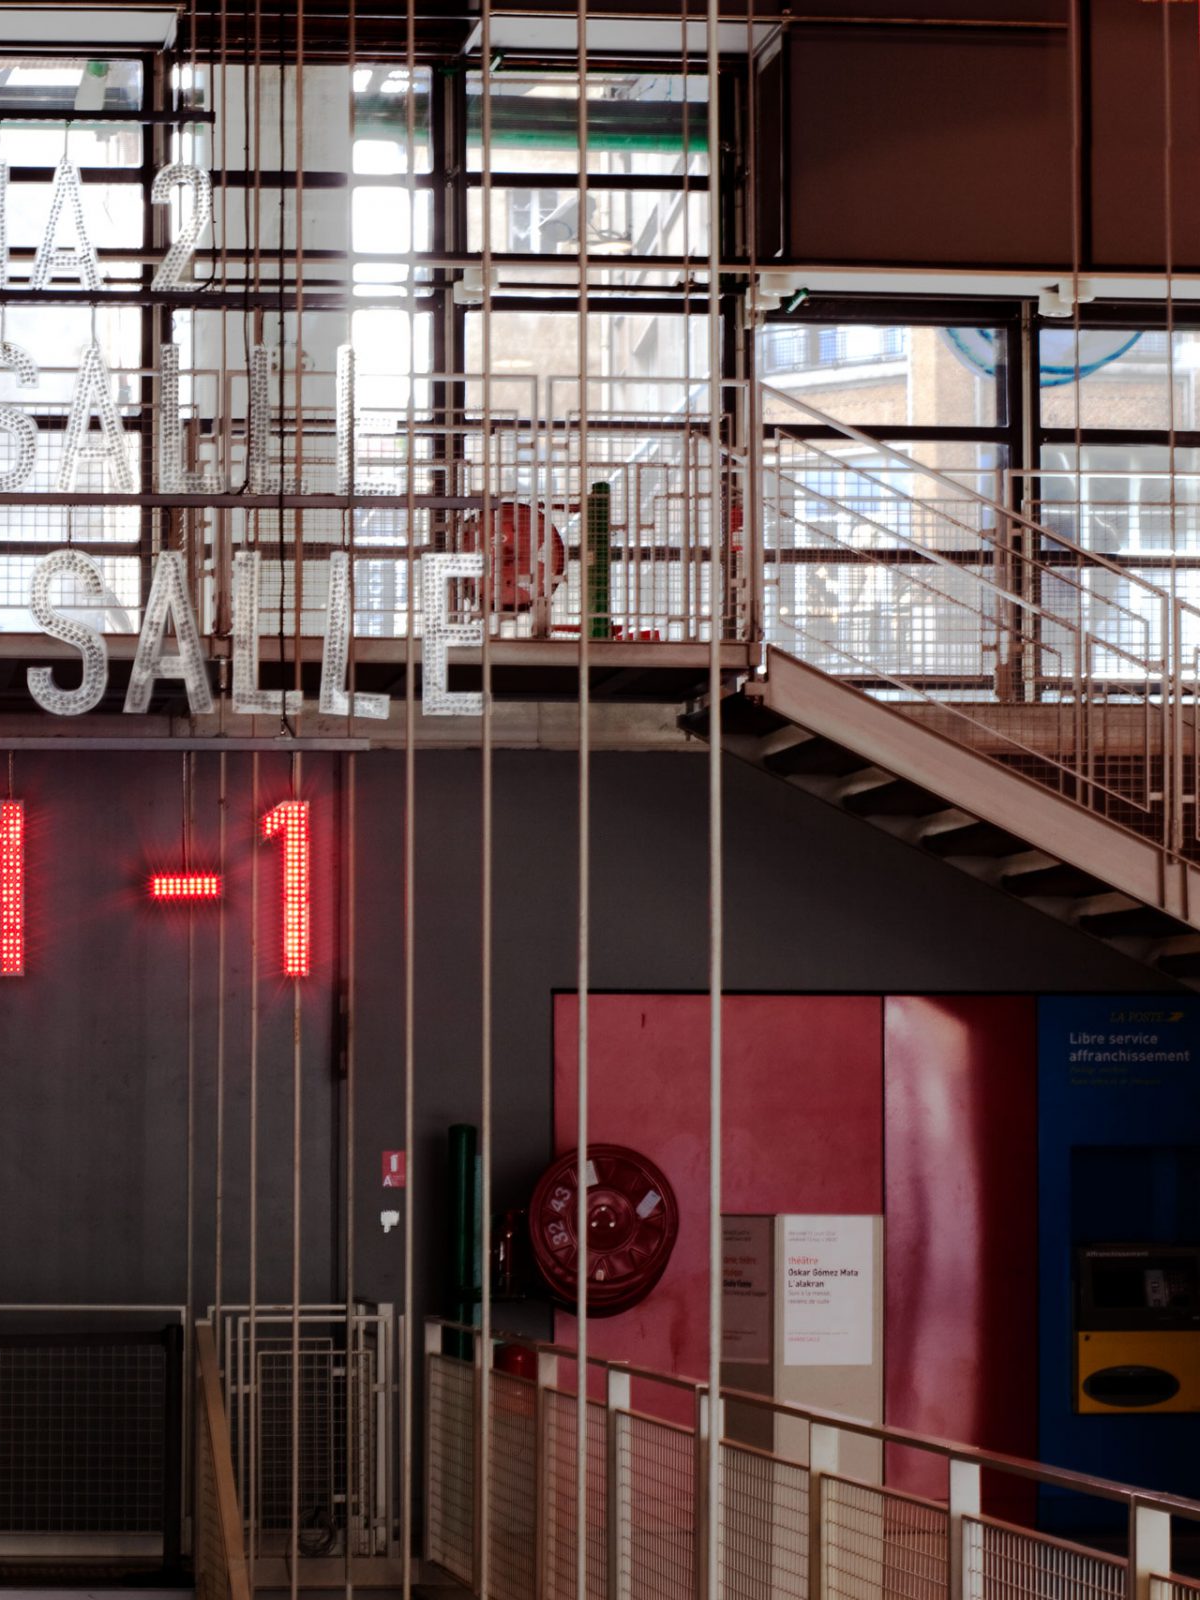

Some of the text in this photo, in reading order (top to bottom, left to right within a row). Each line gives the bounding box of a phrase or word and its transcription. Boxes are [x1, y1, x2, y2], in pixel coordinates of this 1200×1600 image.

[151, 163, 214, 293] 2
[27, 549, 487, 719] SALLE
[1069, 1032, 1158, 1045] Libre service
[1069, 1049, 1190, 1062] affranchissement
[551, 1187, 571, 1212] 43
[812, 1267, 838, 1277] Gómez
[840, 1269, 859, 1277] Mata
[788, 1280, 825, 1288] L'alakran
